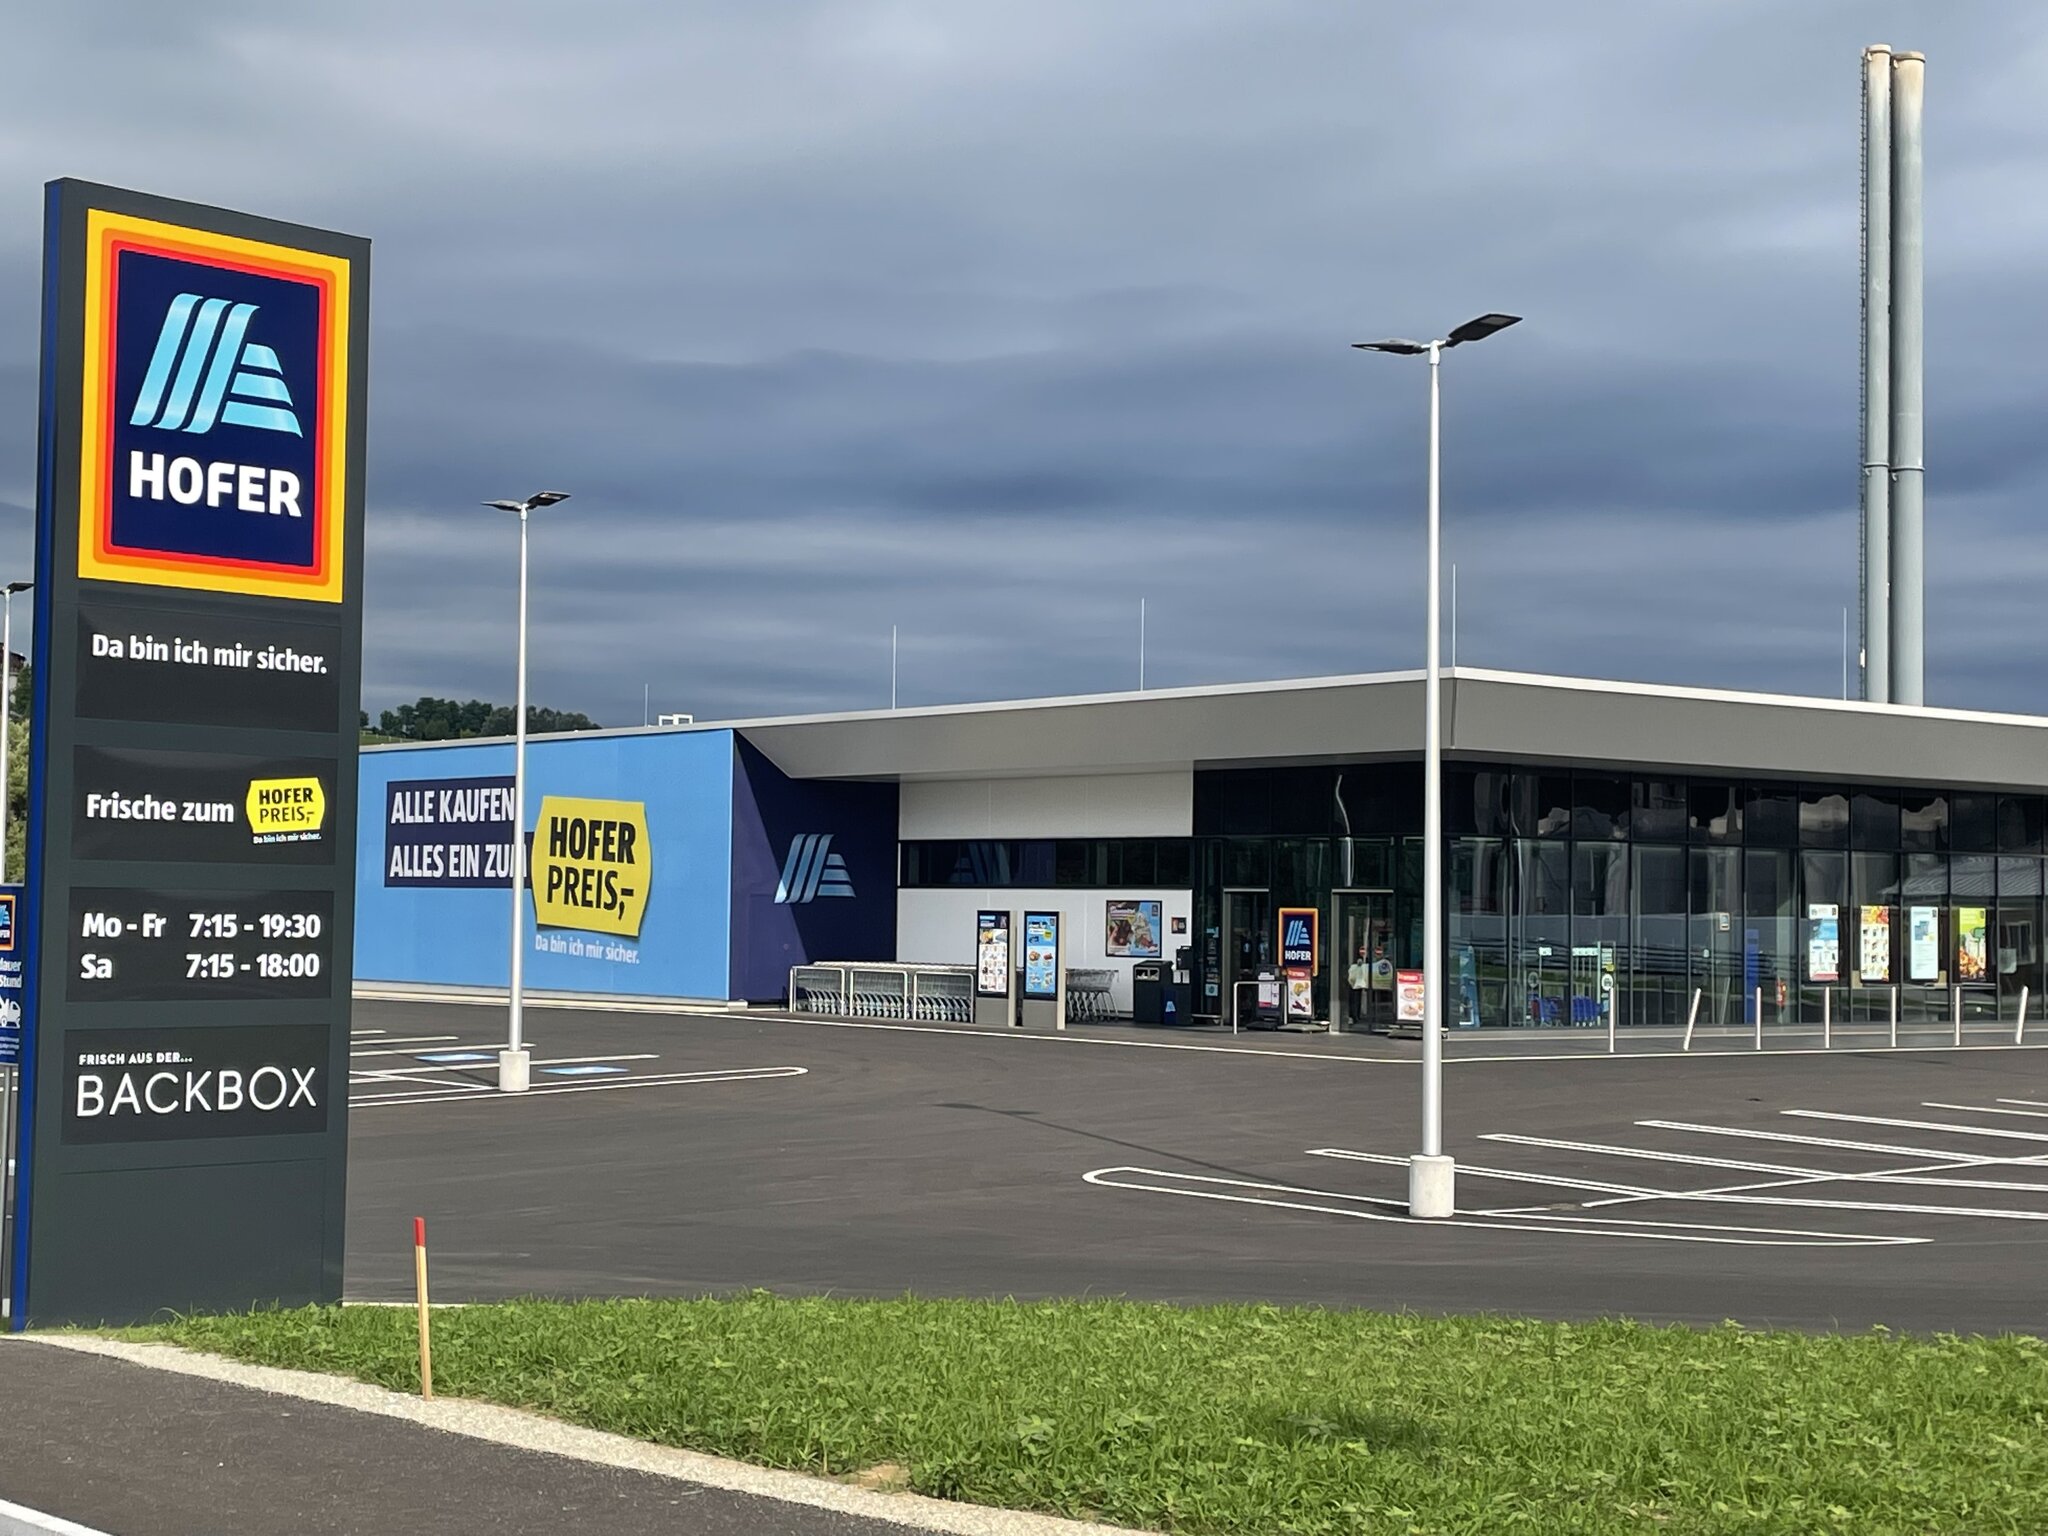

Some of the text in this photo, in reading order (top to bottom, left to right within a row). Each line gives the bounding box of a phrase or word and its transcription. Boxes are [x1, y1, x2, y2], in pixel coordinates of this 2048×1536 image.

[130, 450, 301, 517] HOFER
[93, 634, 327, 674] Da bin ich mir sicher.
[86, 792, 234, 823] Frische zum
[259, 787, 313, 805] HOFER
[391, 787, 515, 824] ALLE KAUFEN
[260, 806, 315, 824] PREIS,-
[253, 836, 262, 844] Da
[263, 834, 275, 843] bin
[276, 834, 287, 842] ich
[549, 816, 635, 865] HOFER
[389, 844, 443, 878] ALLES
[448, 844, 480, 878] EIN
[547, 865, 635, 920] PREIS,-
[81, 912, 121, 938] Mo
[142, 913, 167, 938] Fr
[189, 913, 237, 938] 7:15
[259, 913, 321, 939] 19:30
[535, 934, 640, 965] Da bin ich mir sicher.
[1284, 950, 1312, 961] HOFER
[80, 953, 113, 979] Sa
[186, 953, 234, 978] 7:15
[256, 953, 320, 978] 18:00
[78, 1052, 193, 1066] FRISCH AUS DER...
[77, 1066, 317, 1117] BACKBOX
